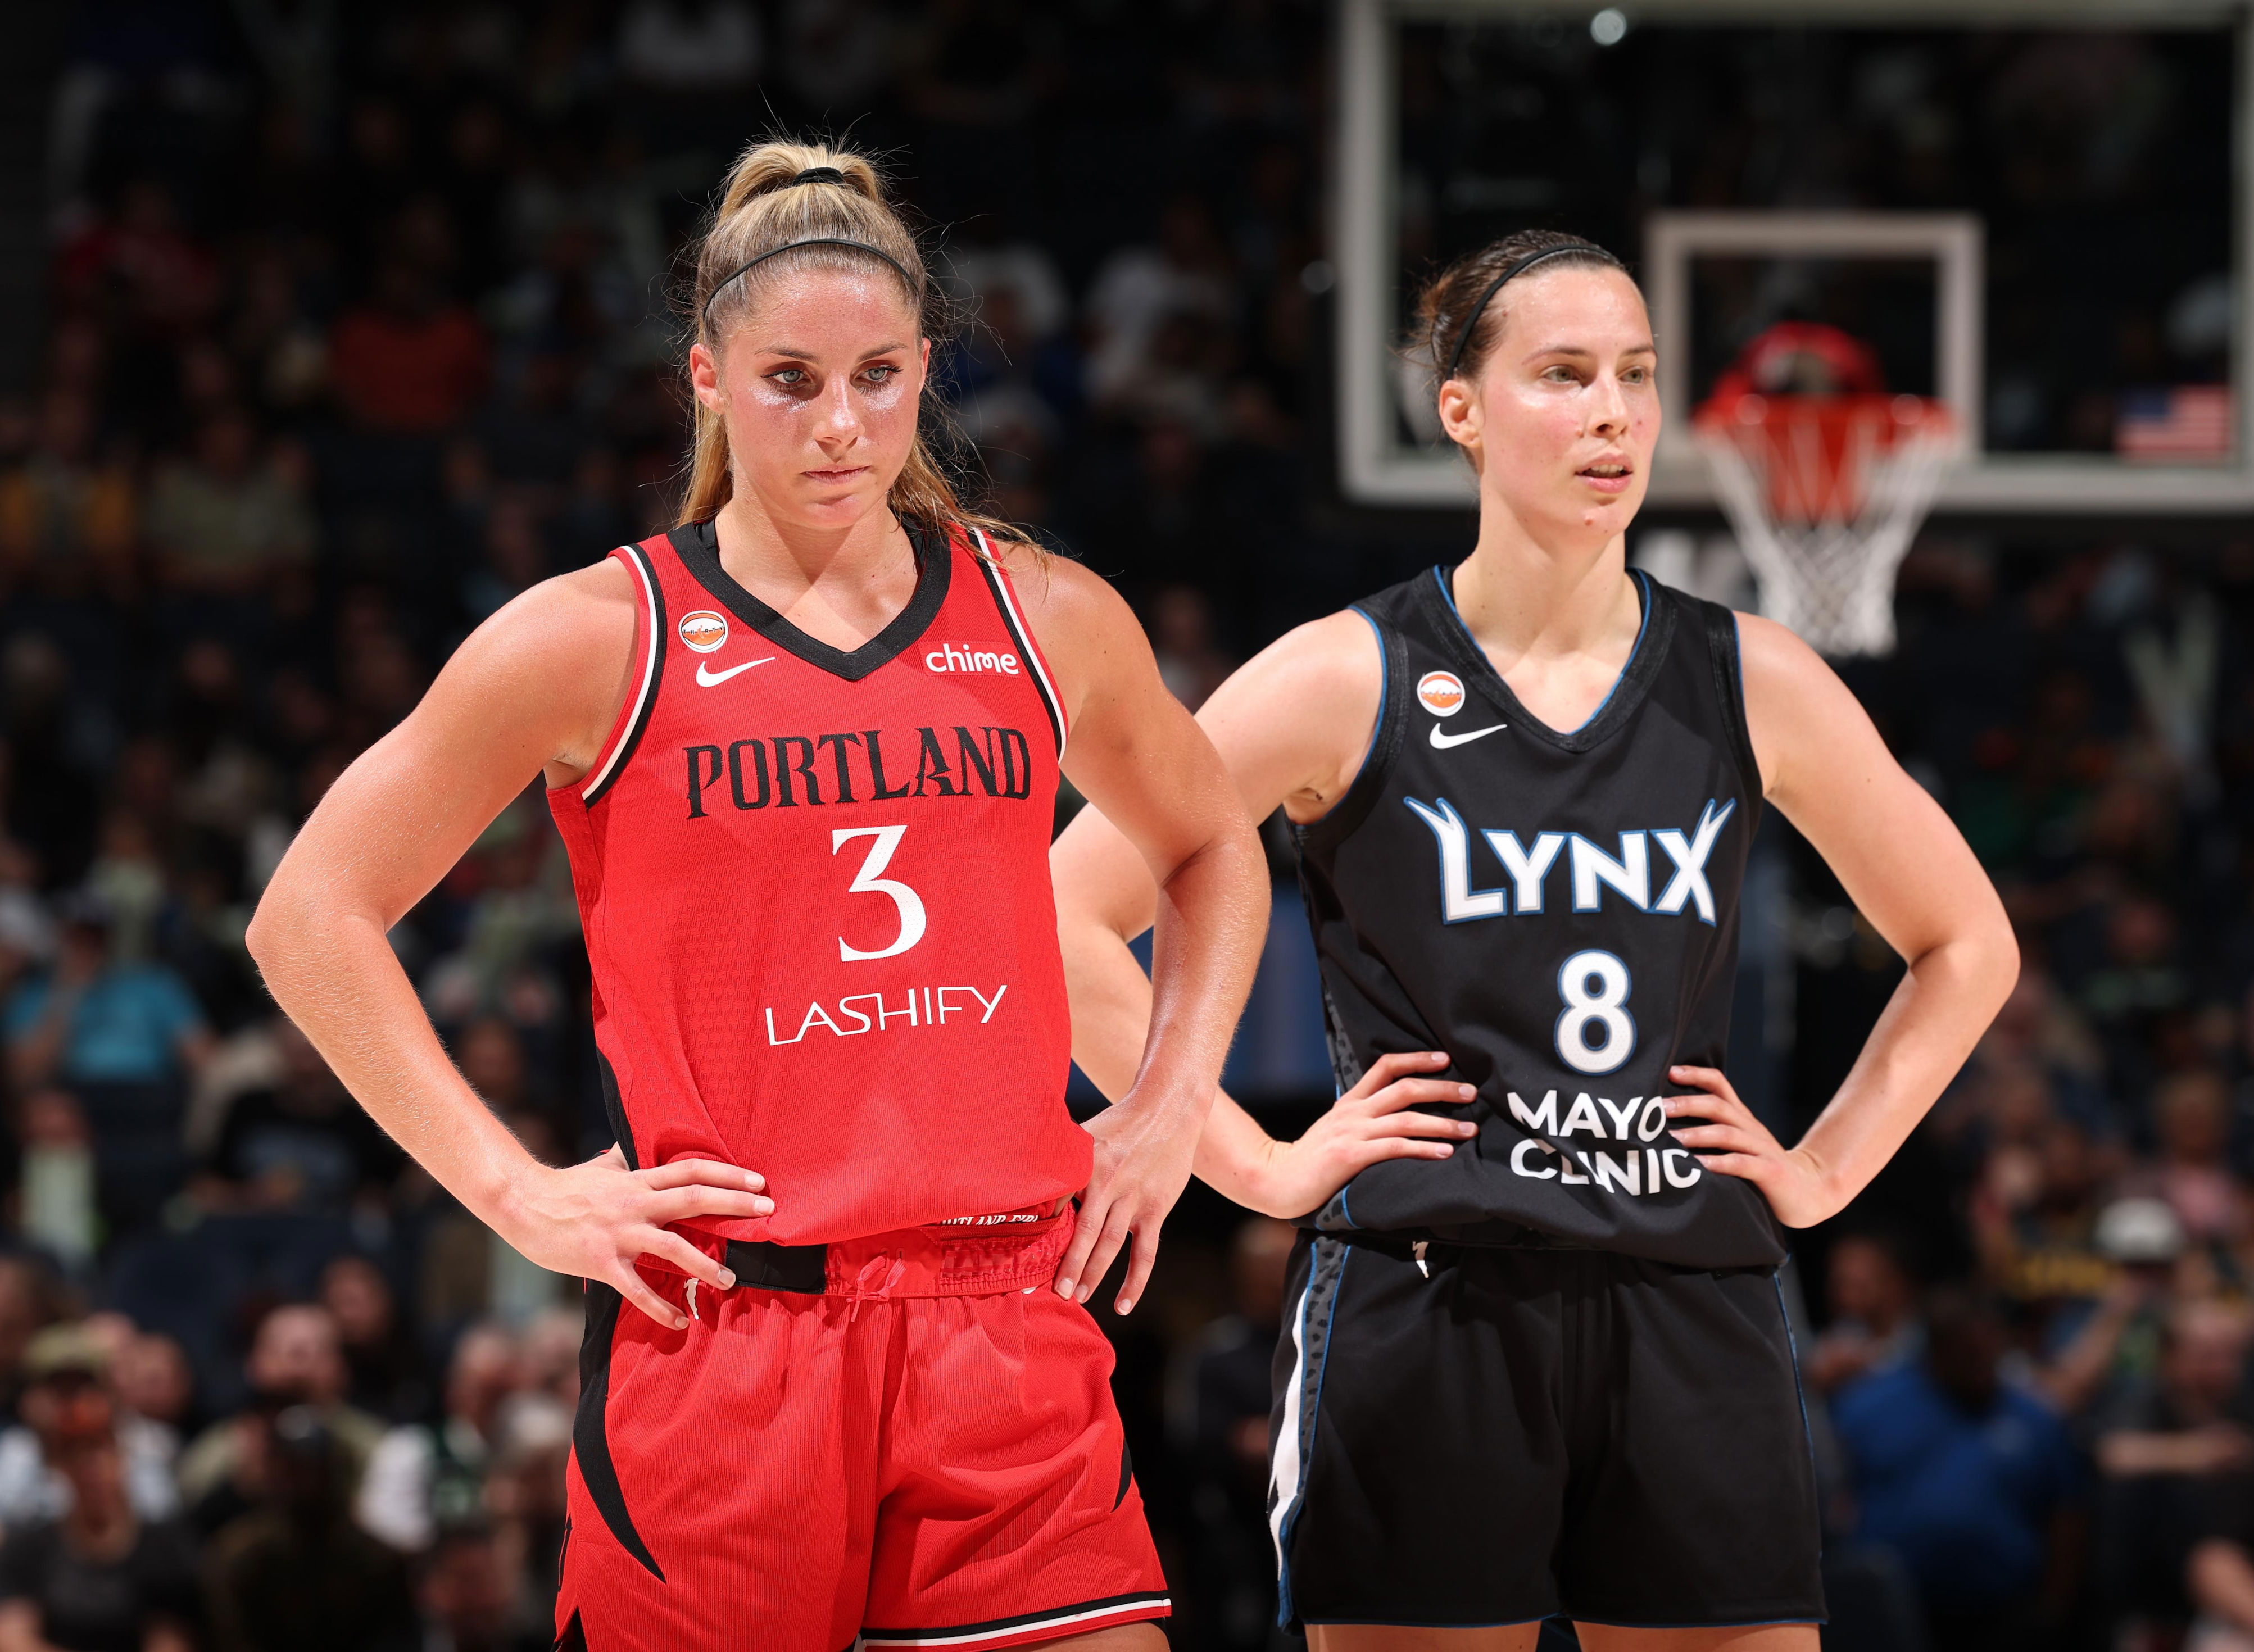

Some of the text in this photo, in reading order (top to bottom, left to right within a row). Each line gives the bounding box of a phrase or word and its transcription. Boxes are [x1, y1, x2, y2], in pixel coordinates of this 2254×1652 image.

[926, 643, 1019, 675] chime
[683, 727, 1031, 820] PORTLAND
[832, 825, 927, 962] 3
[1404, 796, 1736, 927] LYNX
[765, 984, 1008, 1046] LASHIFY
[1554, 949, 1638, 1077] 8
[1507, 1089, 1667, 1142] MAYO
